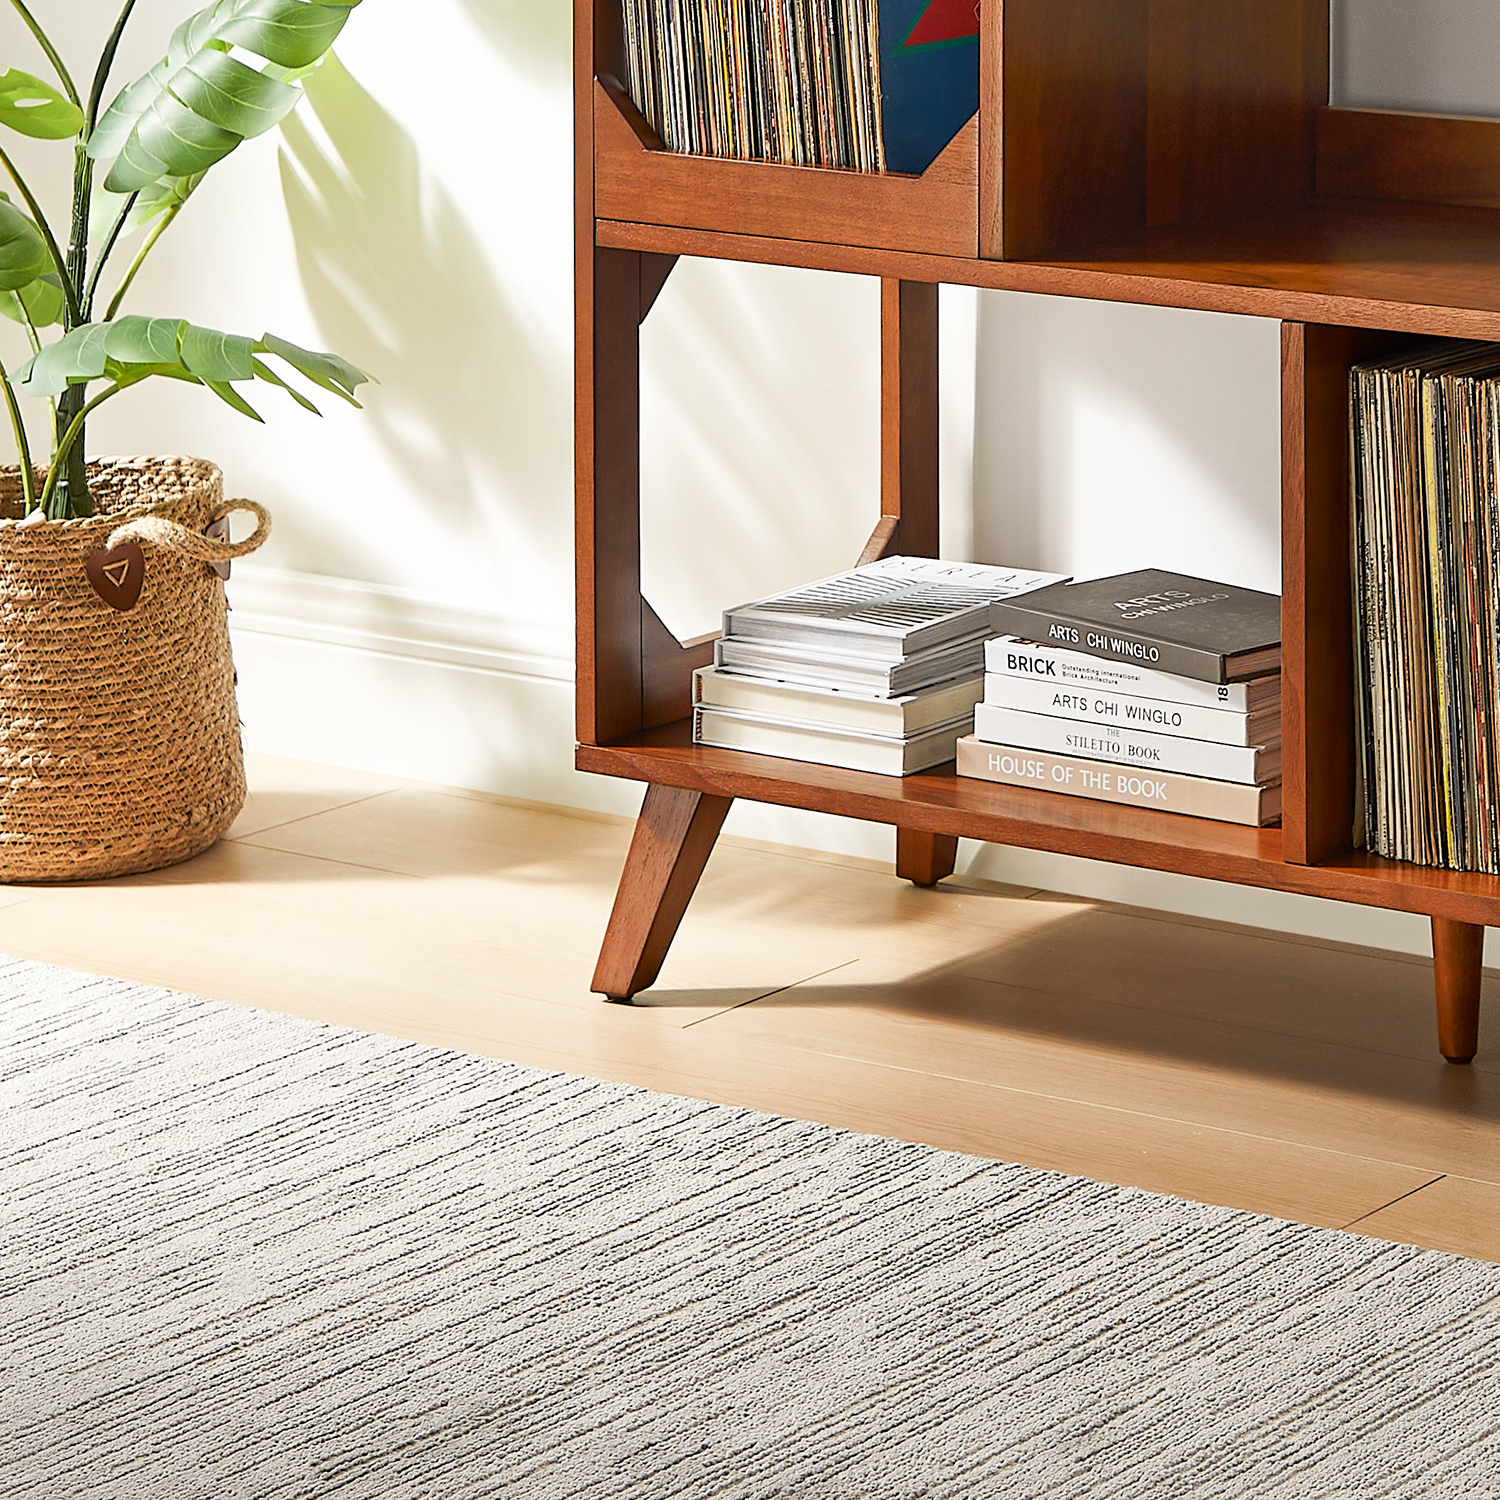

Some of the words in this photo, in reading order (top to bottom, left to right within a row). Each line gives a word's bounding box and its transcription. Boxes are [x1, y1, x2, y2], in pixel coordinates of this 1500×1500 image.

[1113, 590, 1191, 611] ARTS
[1048, 623, 1079, 644] ARTS
[1086, 631, 1107, 650] CHI
[1110, 636, 1160, 662] WINGLO
[1007, 653, 1056, 677] BRICK
[1061, 663, 1099, 676] Outstanding
[1080, 674, 1118, 685] Architecture
[1217, 686, 1229, 702] 18
[1052, 693, 1088, 711] ARTS
[1094, 700, 1118, 716] CHI
[1125, 705, 1182, 727] WINGLO
[1106, 728, 1120, 737] THE
[1065, 734, 1120, 754] STILETTO
[1128, 744, 1160, 761] BOOK
[988, 753, 1045, 780] HOUSE
[1051, 764, 1074, 783] OF
[1080, 769, 1111, 792] THE
[1117, 775, 1167, 800] BOOK
